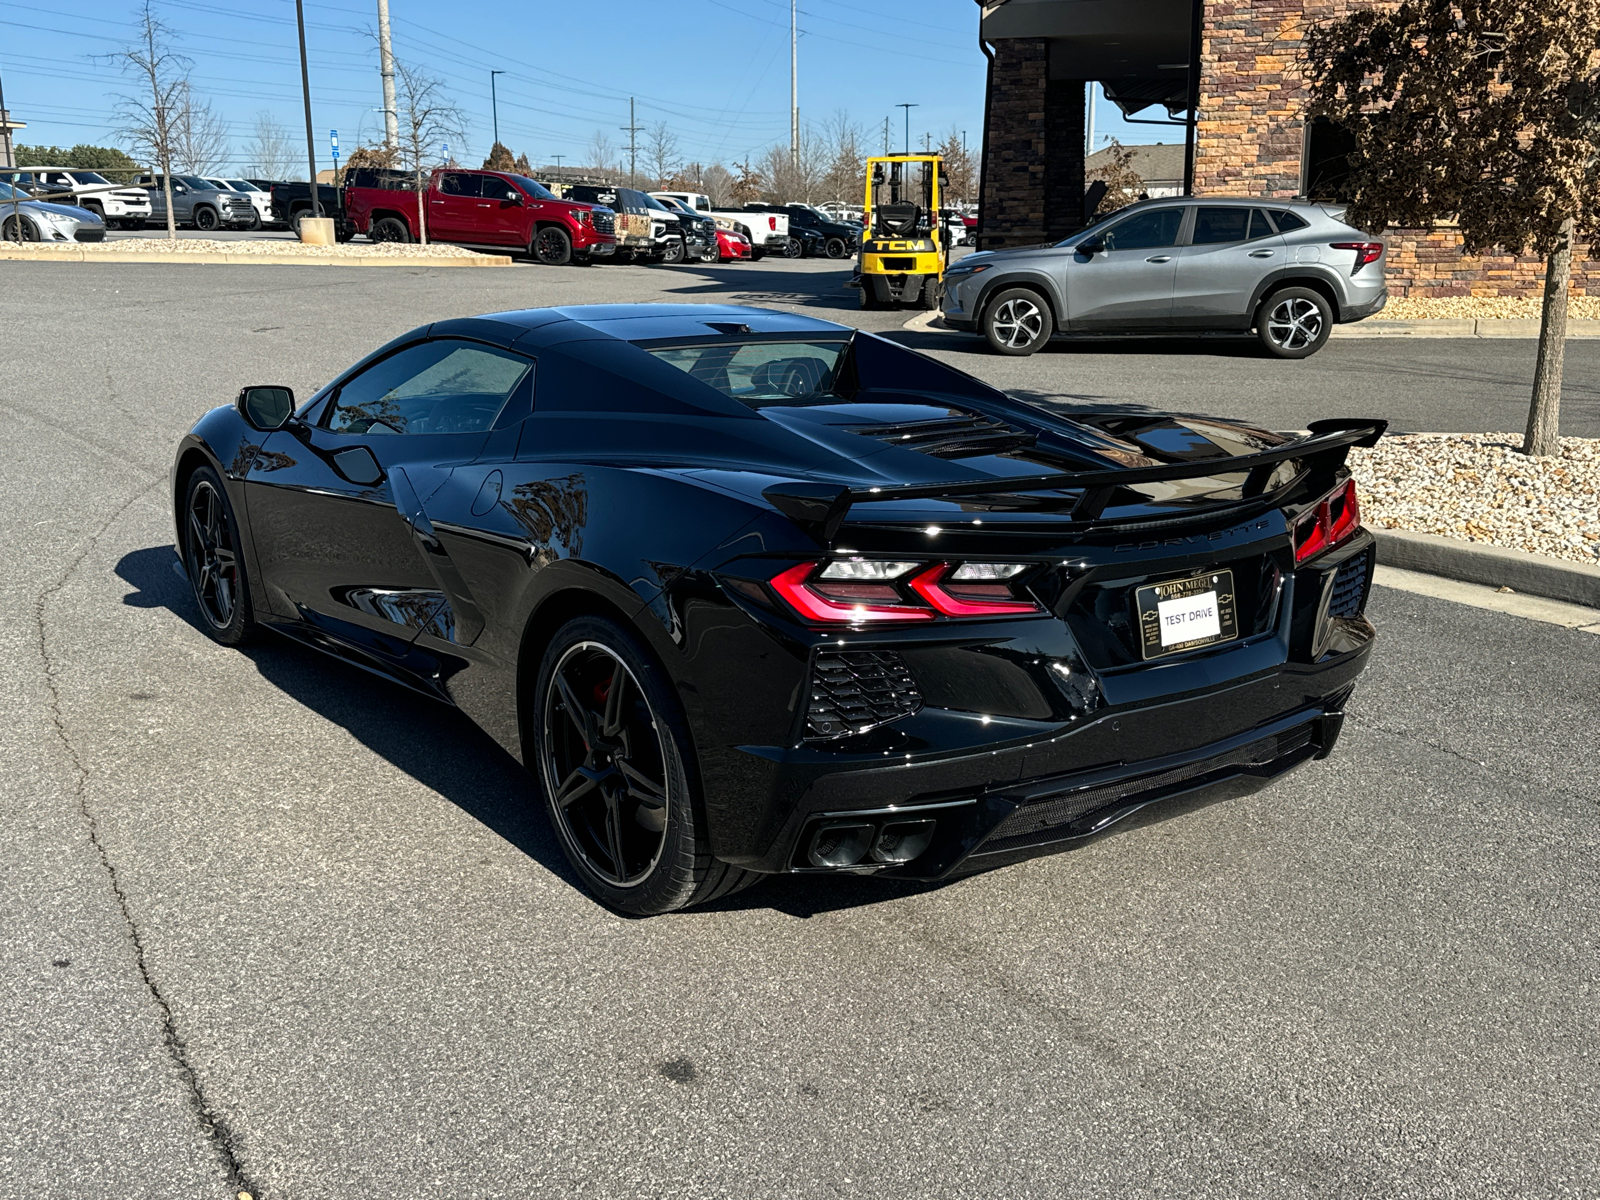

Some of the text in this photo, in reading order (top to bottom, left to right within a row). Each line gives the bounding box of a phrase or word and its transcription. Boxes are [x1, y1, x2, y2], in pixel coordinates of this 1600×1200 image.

[873, 240, 925, 251] TCM
[1113, 519, 1270, 553] CORVETTE
[1159, 576, 1212, 600] JOHN MEGEL
[1165, 613, 1187, 626] TEST
[1189, 607, 1213, 621] DRIVE
[1185, 636, 1215, 647] DAWSONVILLE
